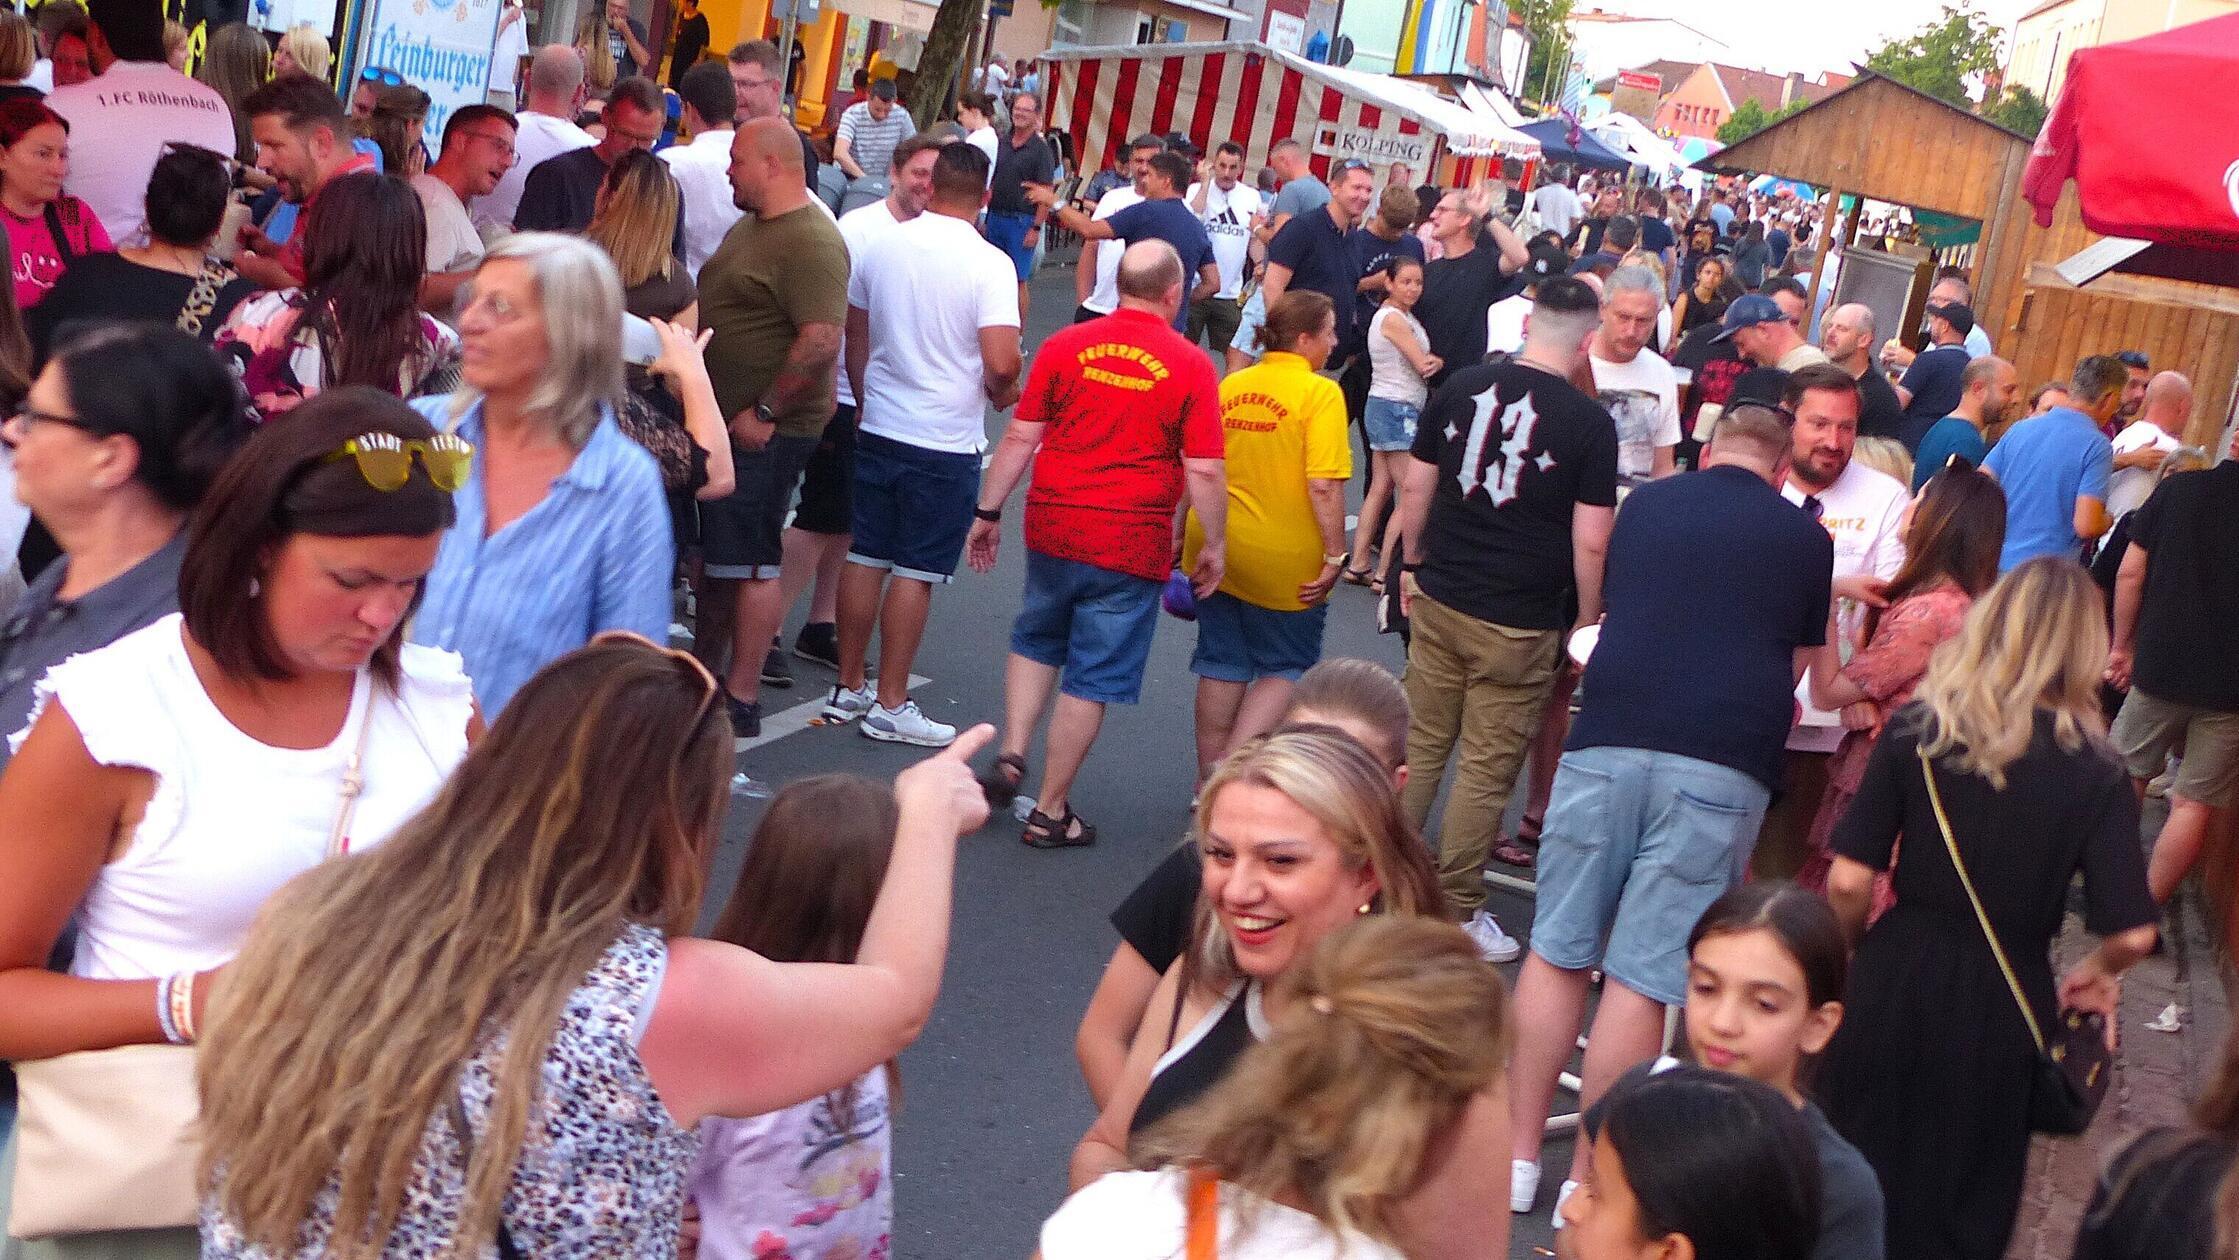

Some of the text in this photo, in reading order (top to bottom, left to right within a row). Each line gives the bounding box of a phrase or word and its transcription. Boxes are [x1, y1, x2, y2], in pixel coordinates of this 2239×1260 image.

[138, 90, 219, 113] Röthenbach
[1341, 132, 1424, 161] KOLPING
[1205, 223, 1245, 237] adidas
[1077, 343, 1170, 381] FEUERWEHR
[1220, 392, 1288, 421] FEUERWEHR
[358, 431, 401, 453] STADT
[1456, 382, 1542, 508] 13
